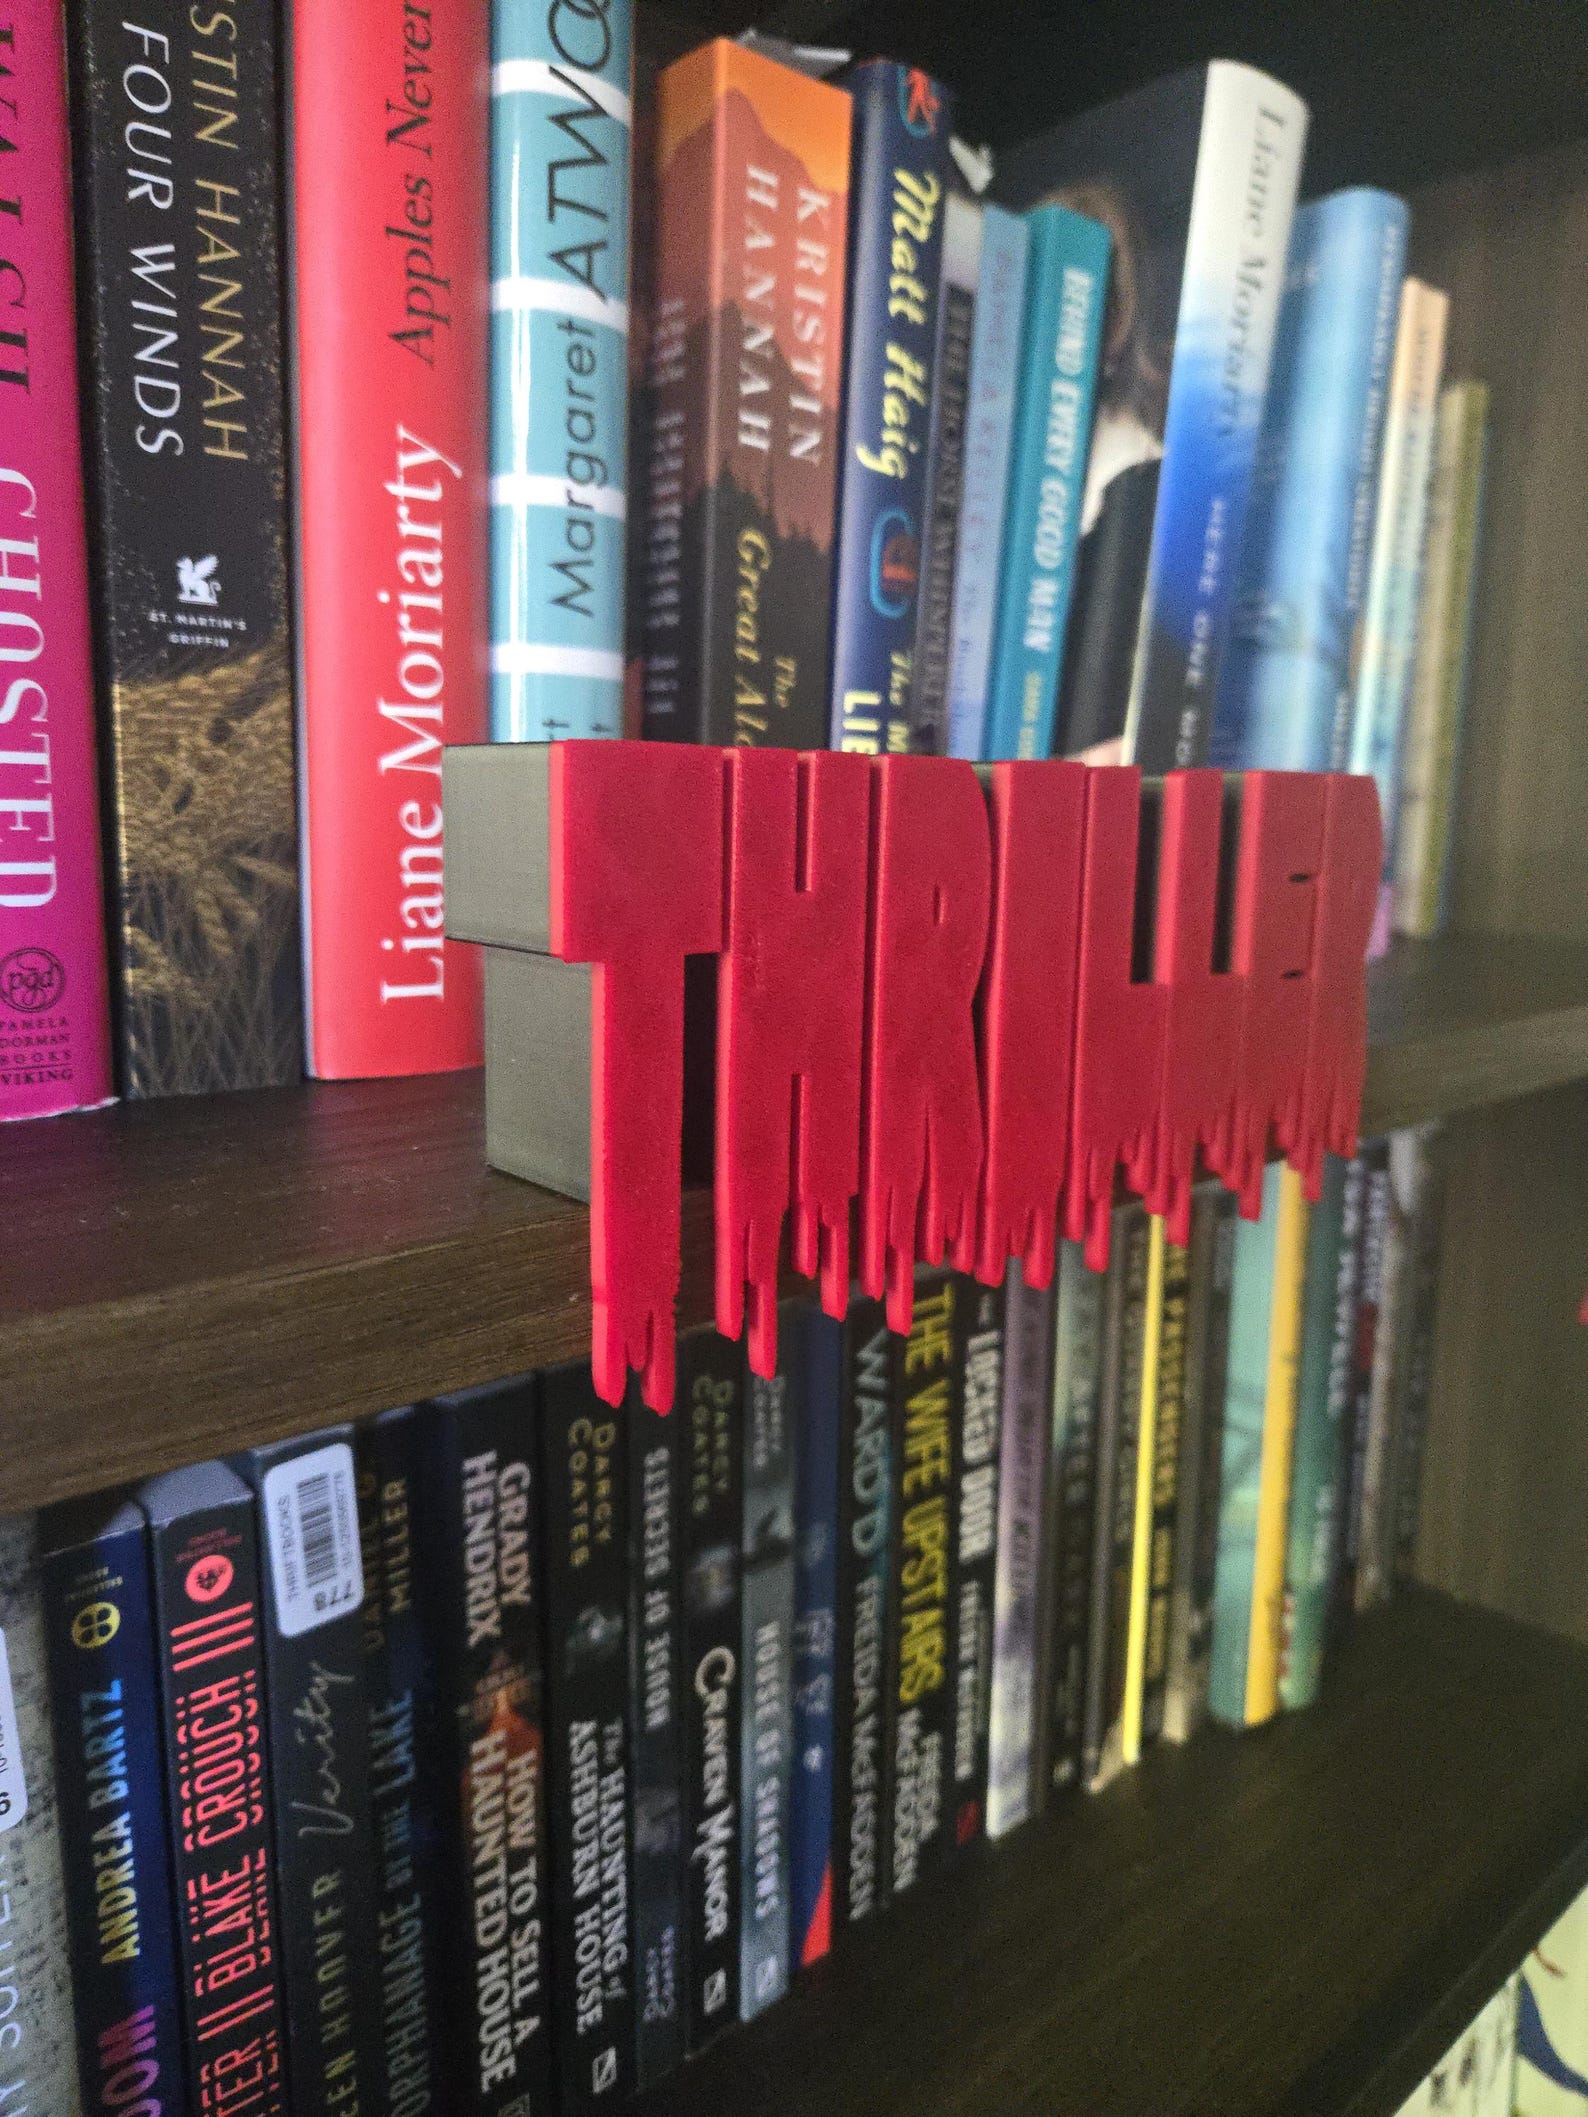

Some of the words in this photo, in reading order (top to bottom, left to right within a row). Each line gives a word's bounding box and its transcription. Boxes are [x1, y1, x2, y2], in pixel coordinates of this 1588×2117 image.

[121, 20, 174, 210] FOUR
[190, 0, 238, 148] STIN
[385, 0, 433, 159] Never
[547, 0, 611, 305] ATWO
[1242, 103, 1286, 239] Liane
[195, 178, 248, 460] HANNAH
[386, 172, 451, 371] Apples
[737, 164, 779, 455] HANNAH
[888, 168, 941, 327] Matt
[128, 243, 184, 457] WINDS
[790, 186, 833, 466] KRISTIN
[549, 318, 610, 619] Margaret
[855, 342, 926, 481] Haig
[167, 631, 230, 648] GRIFFIN
[378, 423, 462, 777] Moriarty
[735, 526, 773, 668] Great
[733, 673, 768, 748] Alo
[773, 654, 797, 709] The
[378, 800, 446, 1005] Liane
[1, 1068, 73, 1086] VIKING
[902, 1283, 957, 1376] THE
[592, 1421, 617, 1547] DARCY
[852, 1328, 889, 1502] WARD
[900, 1377, 953, 1498] WIFE
[462, 1449, 502, 1649] HENDRIX
[496, 1460, 533, 1607] GRADY
[567, 1417, 593, 1569] COATES
[83, 1677, 131, 1809] BARTZ
[173, 1667, 264, 1852] CROUCH
[293, 1660, 358, 1839] Verity
[506, 1748, 541, 1849] HOW
[569, 1718, 603, 1900] ASHBURN
[92, 1811, 142, 1964] ANDREA
[469, 1730, 509, 1951] HAUNTED
[508, 1855, 539, 1916] TO
[600, 1765, 629, 1973] HAUNTING
[689, 1803, 736, 1943] MANOR
[189, 1847, 273, 1998] BLAKE
[511, 1919, 542, 2009] SELL
[573, 1902, 603, 2037] HOUSE
[477, 1944, 518, 2093] HOUSE
[512, 2008, 541, 2046] A
